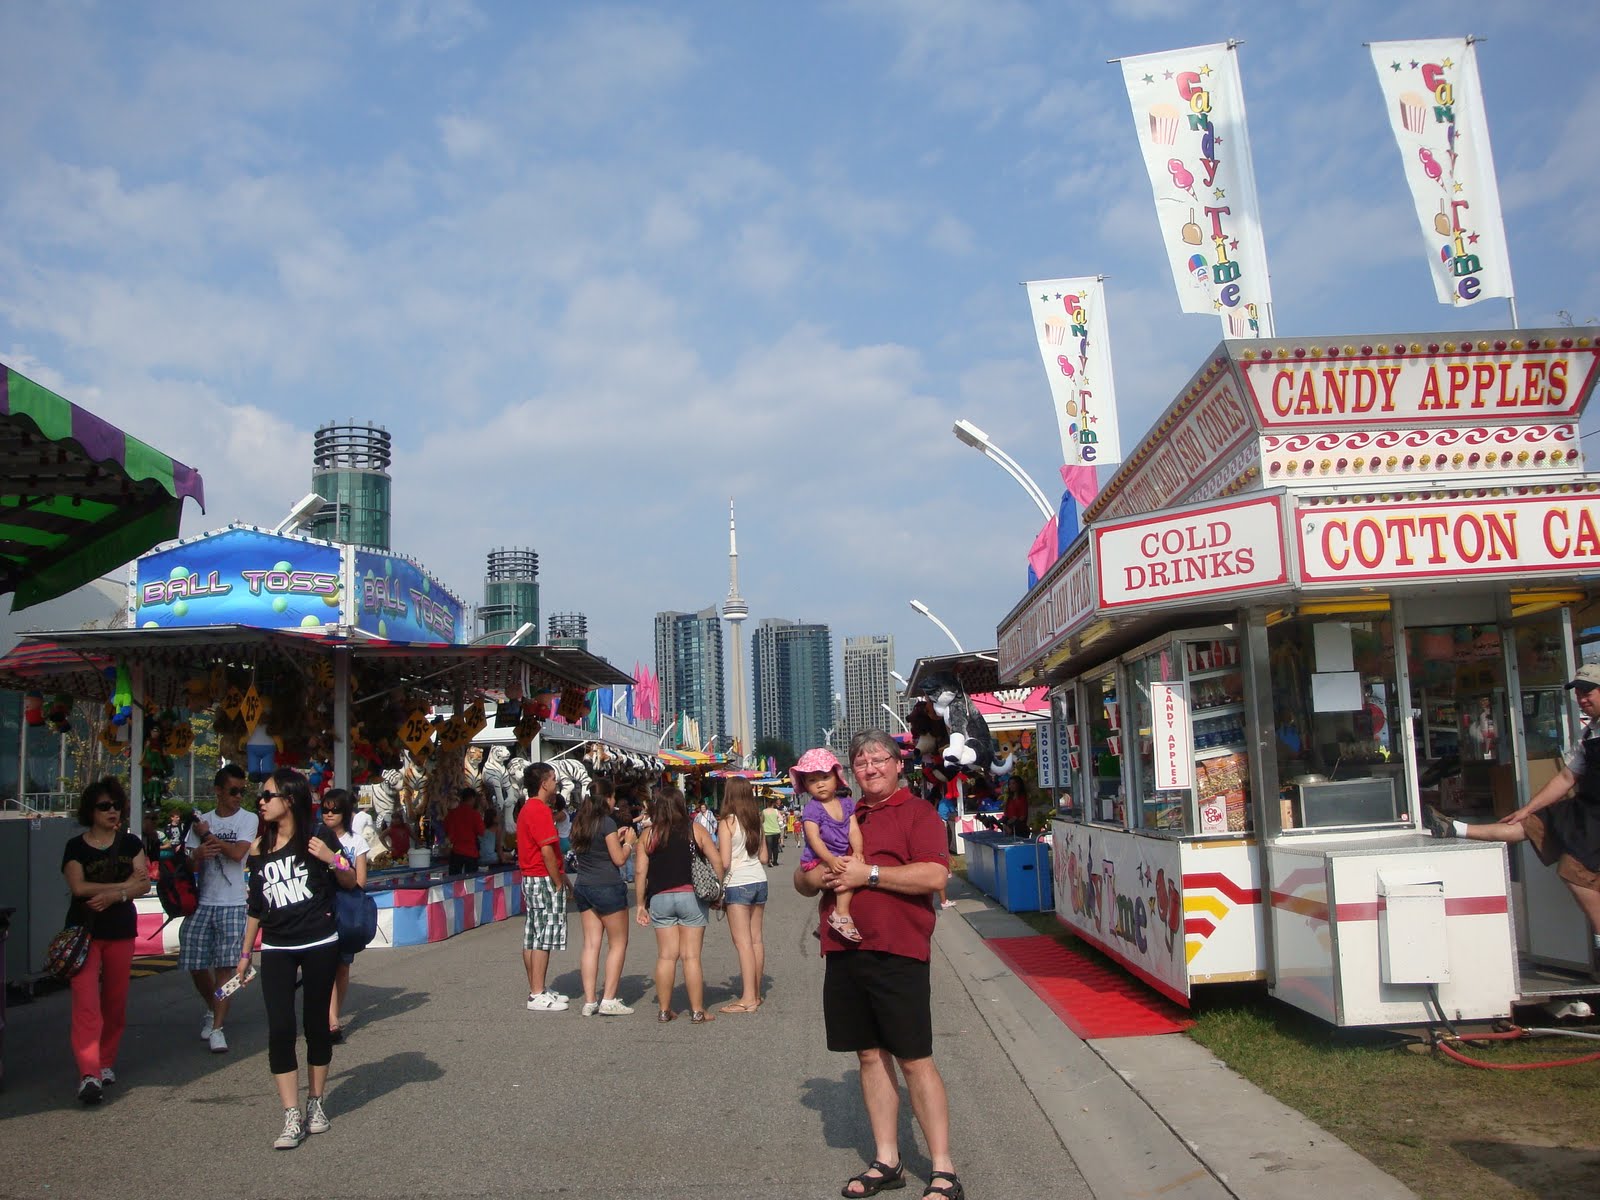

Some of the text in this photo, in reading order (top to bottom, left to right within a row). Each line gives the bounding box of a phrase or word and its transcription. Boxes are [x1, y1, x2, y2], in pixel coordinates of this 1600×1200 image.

[1204, 206, 1242, 308] Time
[1271, 359, 1569, 417] CANDY APPLES
[1078, 389, 1099, 462] Time
[1174, 384, 1247, 474] SNO CONES
[1124, 548, 1255, 591] DRINKS
[1140, 521, 1232, 559] COLD
[1321, 507, 1600, 571] COTTON CA
[142, 569, 341, 606] BALL TOSS
[362, 576, 456, 643] BALL TOSS
[406, 719, 429, 743] 25¢
[1165, 687, 1177, 785] CANDY APPLES
[258, 854, 309, 885] OVE
